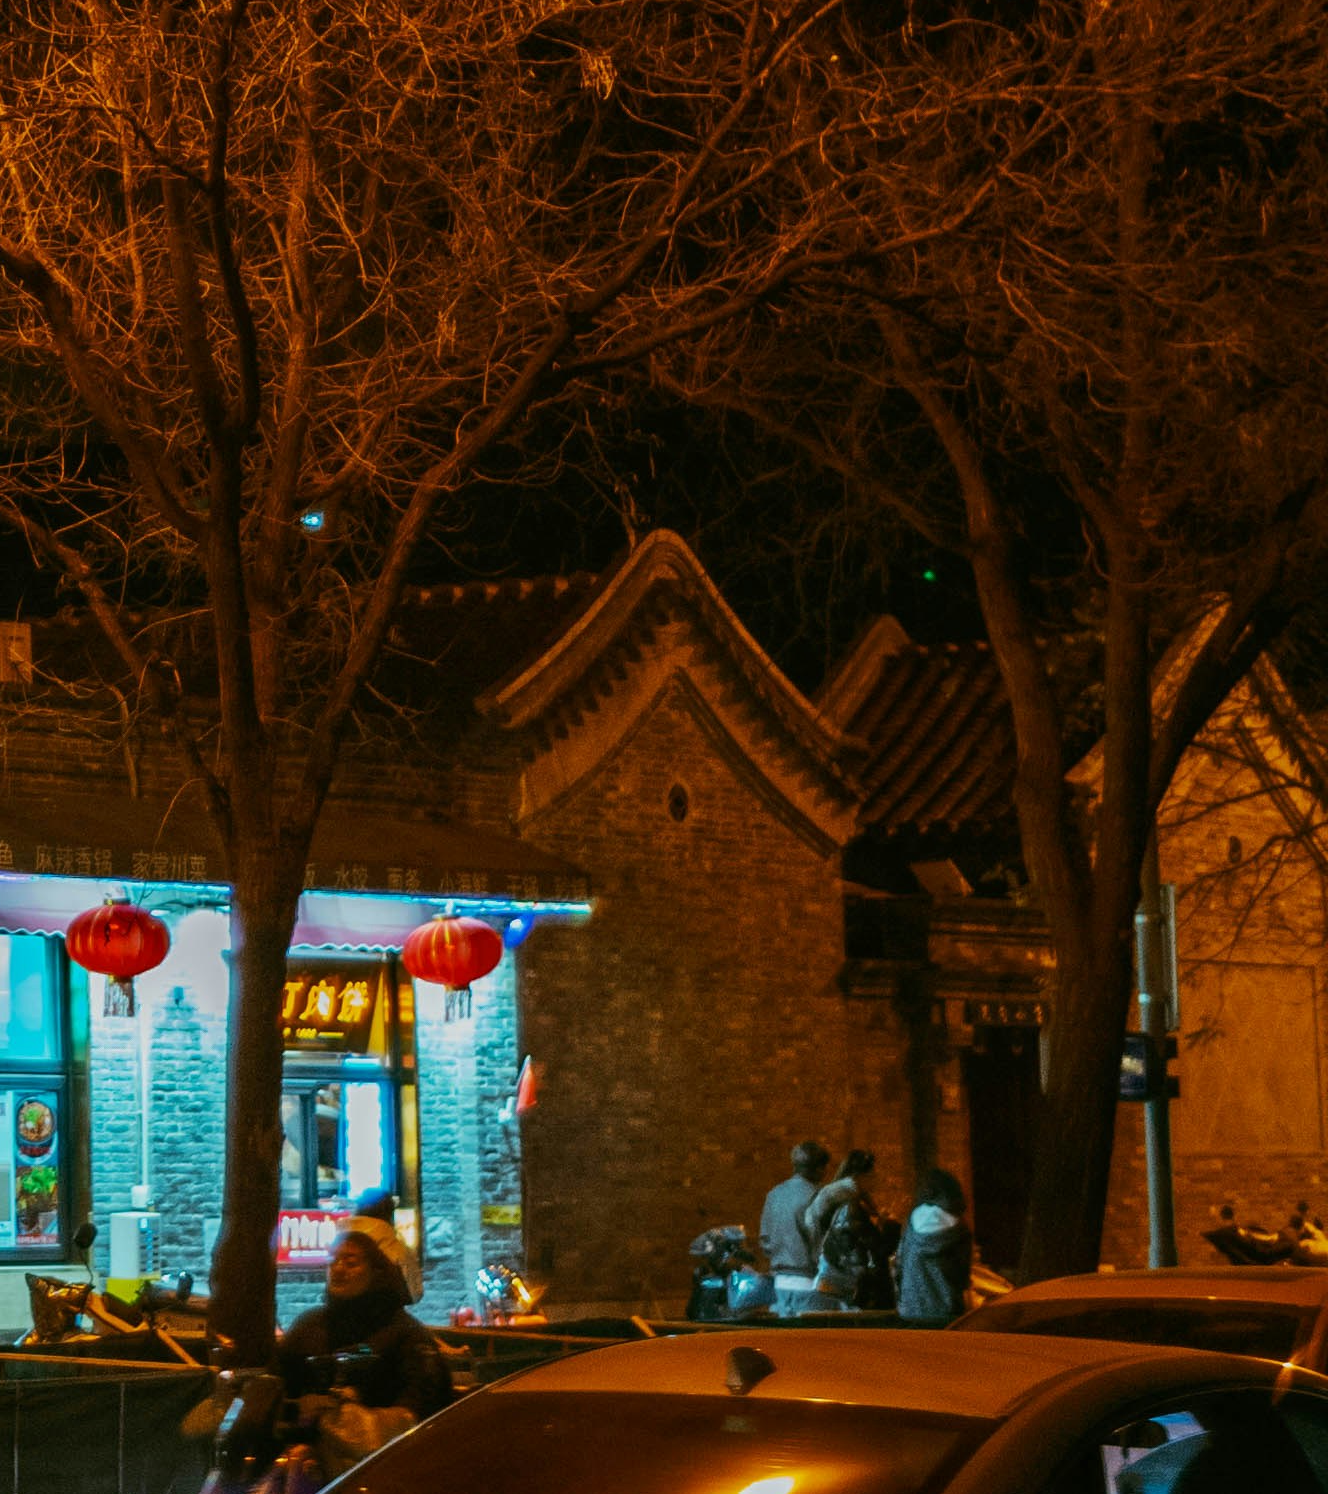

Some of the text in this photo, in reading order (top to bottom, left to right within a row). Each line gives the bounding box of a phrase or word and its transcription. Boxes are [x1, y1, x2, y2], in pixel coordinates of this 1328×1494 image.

[34, 843, 113, 876] 麻辣香锅
[131, 851, 207, 882] 家常川菜
